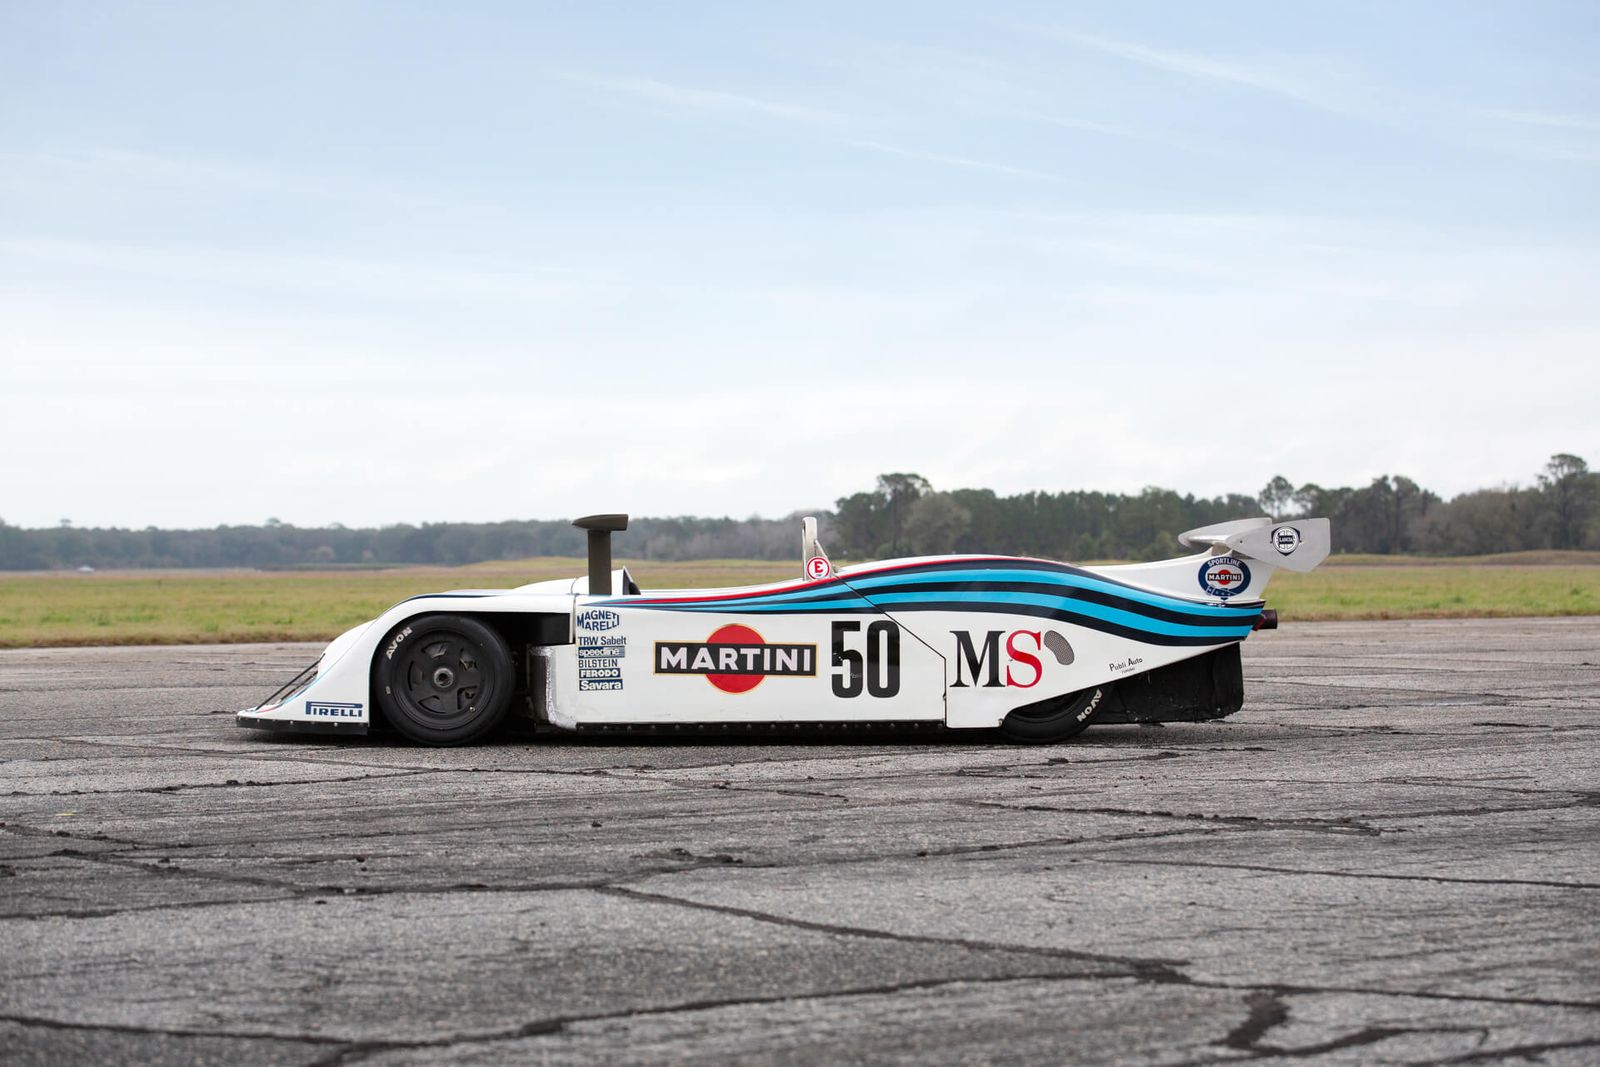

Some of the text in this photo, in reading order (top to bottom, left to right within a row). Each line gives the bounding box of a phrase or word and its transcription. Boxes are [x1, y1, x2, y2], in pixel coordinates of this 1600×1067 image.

[813, 560, 824, 573] E
[1207, 557, 1241, 567] SPORTLINE
[386, 626, 413, 660] AVON
[577, 635, 627, 646] TRW Sabelt
[578, 658, 618, 668] BILSTEIN
[660, 646, 811, 673] MARTINI
[831, 620, 900, 698] 50
[949, 629, 1042, 689] MS
[1128, 657, 1143, 666] Auto
[580, 669, 619, 678] FERODO
[580, 680, 622, 690] Savara
[305, 700, 363, 718] PIRELLI
[1076, 688, 1103, 722] AVON
